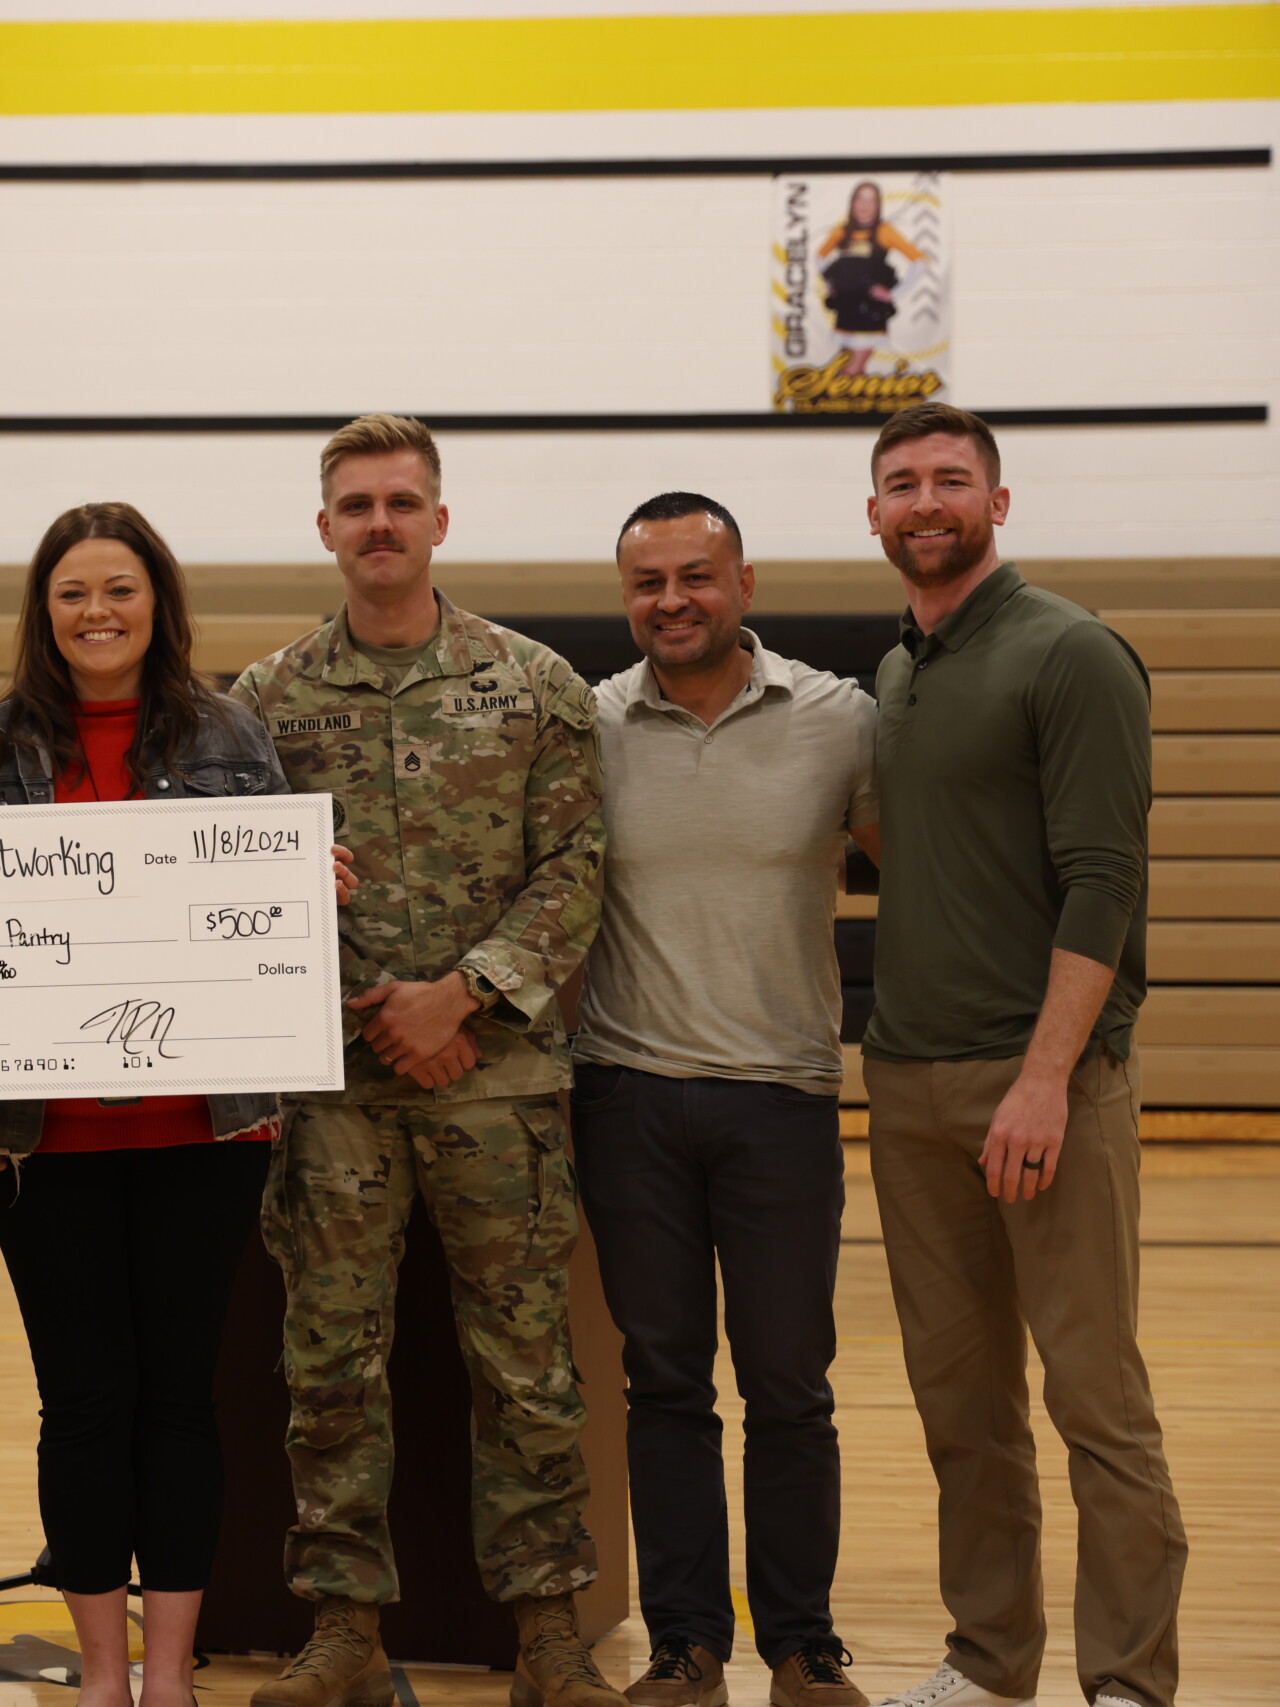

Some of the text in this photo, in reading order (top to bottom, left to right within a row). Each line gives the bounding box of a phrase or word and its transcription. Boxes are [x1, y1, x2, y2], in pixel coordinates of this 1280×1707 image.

[785, 182, 809, 358] GRACELYN
[277, 714, 352, 735] WENDLAND
[144, 852, 177, 865] Date
[193, 823, 300, 864] 11/8/2024
[5, 918, 71, 965] Pantry
[258, 962, 307, 975] Dollars
